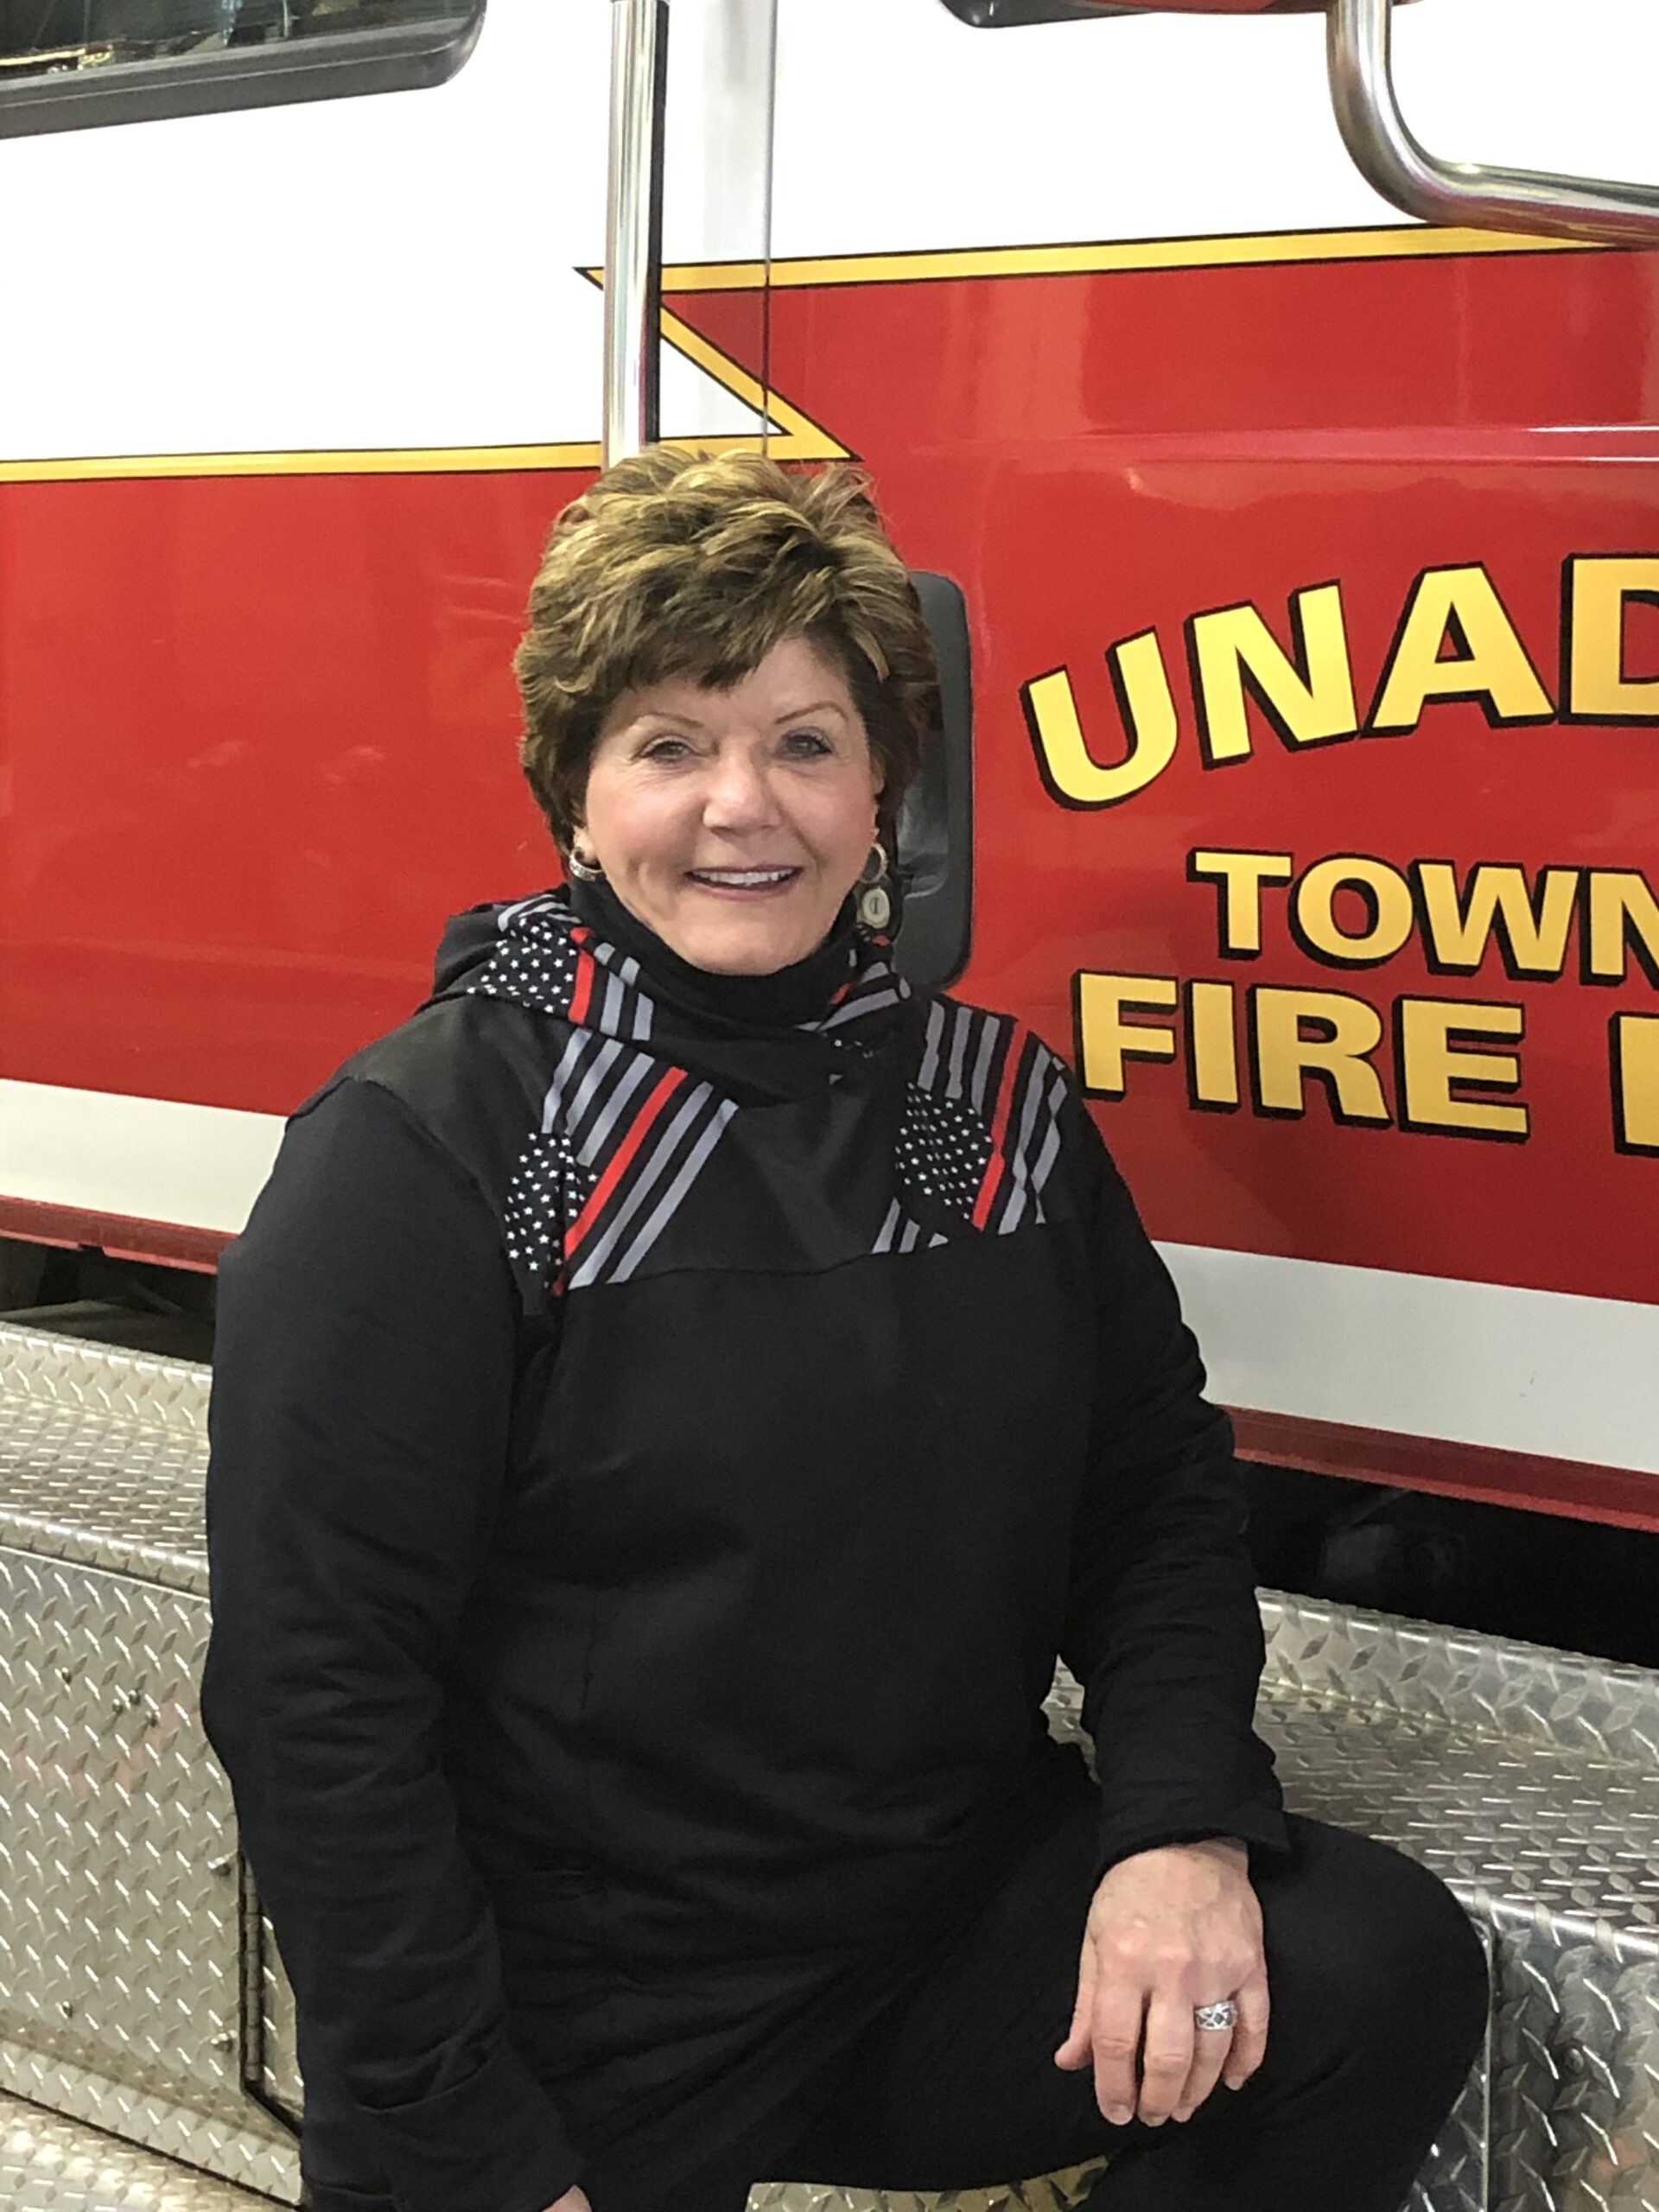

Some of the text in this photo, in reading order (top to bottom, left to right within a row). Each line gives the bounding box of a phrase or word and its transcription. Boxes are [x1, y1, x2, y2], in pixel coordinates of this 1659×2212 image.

[1020, 551, 1659, 810] UNAD
[1187, 847, 1659, 990] TOWN
[1072, 969, 1530, 1143] FIRE
